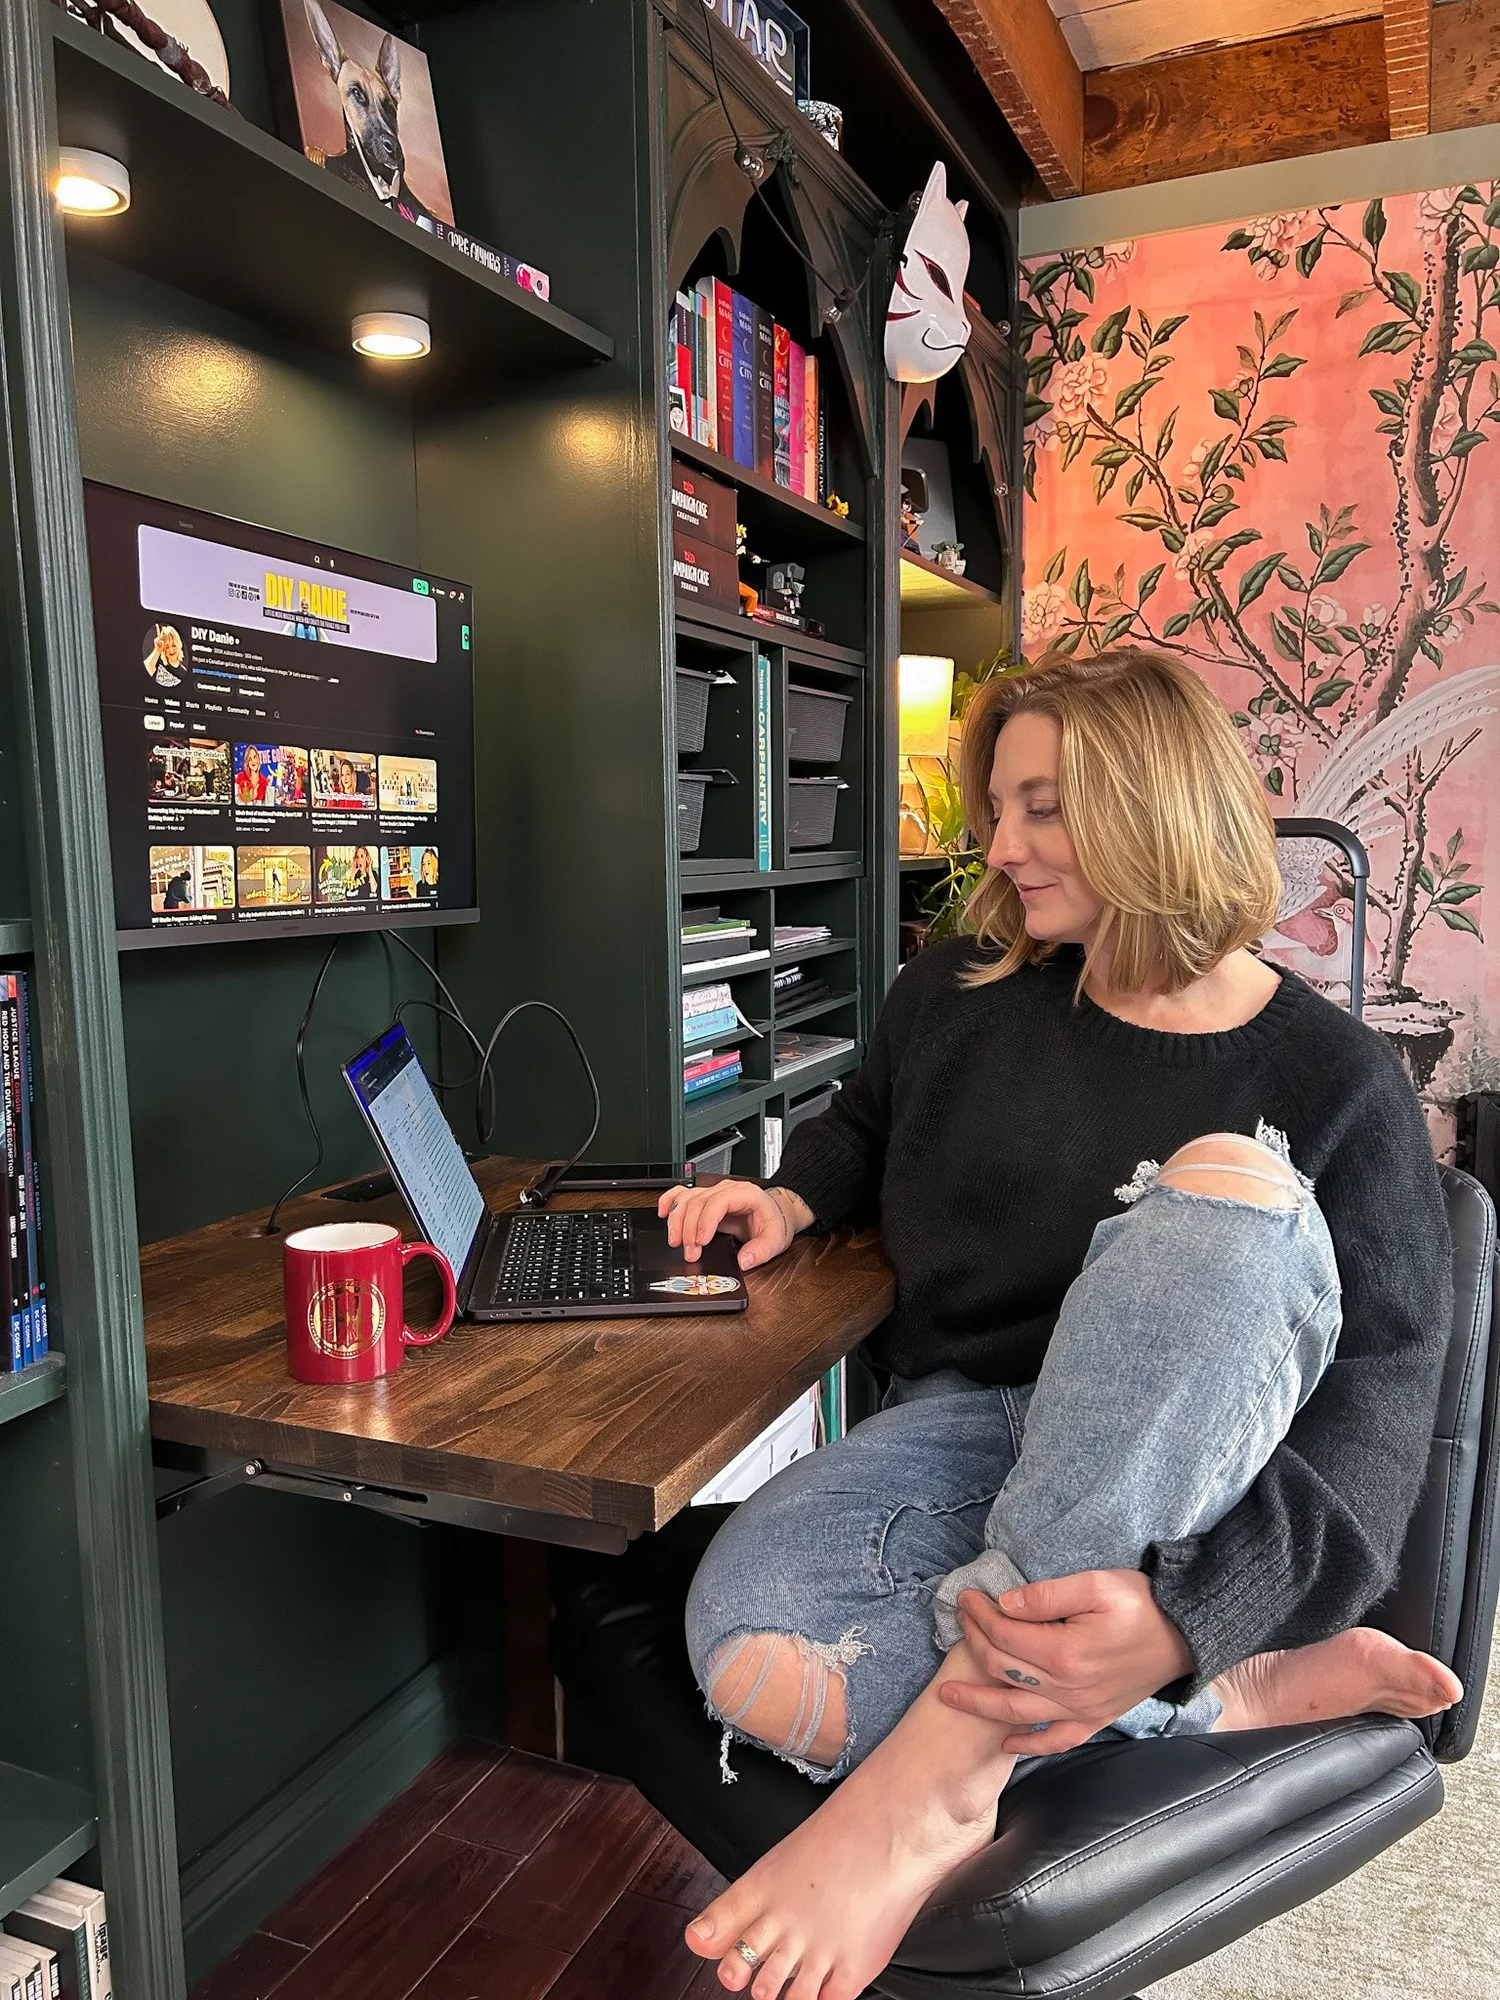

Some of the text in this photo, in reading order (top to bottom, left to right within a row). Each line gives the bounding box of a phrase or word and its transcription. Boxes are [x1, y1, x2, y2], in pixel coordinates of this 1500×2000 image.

[703, 0, 793, 81] TAR
[671, 488, 708, 519] AMPAIGN CASE
[673, 559, 710, 587] AMPAIGN CASE
[265, 572, 294, 610] DIY
[298, 580, 349, 622] DANIE
[191, 626, 235, 646] DIY Danie
[144, 696, 159, 705] Home
[164, 698, 181, 707] Videos
[185, 701, 200, 709] Shorts
[204, 703, 223, 712] Playlists
[226, 706, 250, 716] Community
[184, 749, 192, 758] for
[260, 750, 272, 765] THE
[758, 712, 767, 826] CARPENTRY
[10, 1006, 19, 1043] JUSTICE
[12, 1044, 20, 1080] LEAGUE
[1, 1010, 9, 1027] RED
[6, 1127, 14, 1178] REDEMPTION
[13, 1298, 18, 1307] 1
[23, 1292, 28, 1300] 1
[35, 1309, 40, 1319] DC
[41, 1304, 47, 1314] DC
[14, 1320, 20, 1331] DC
[24, 1314, 30, 1324] DC
[99, 1921, 109, 1961] Image
[51, 1963, 60, 1998] Image
[27, 1980, 35, 2000] Ima
